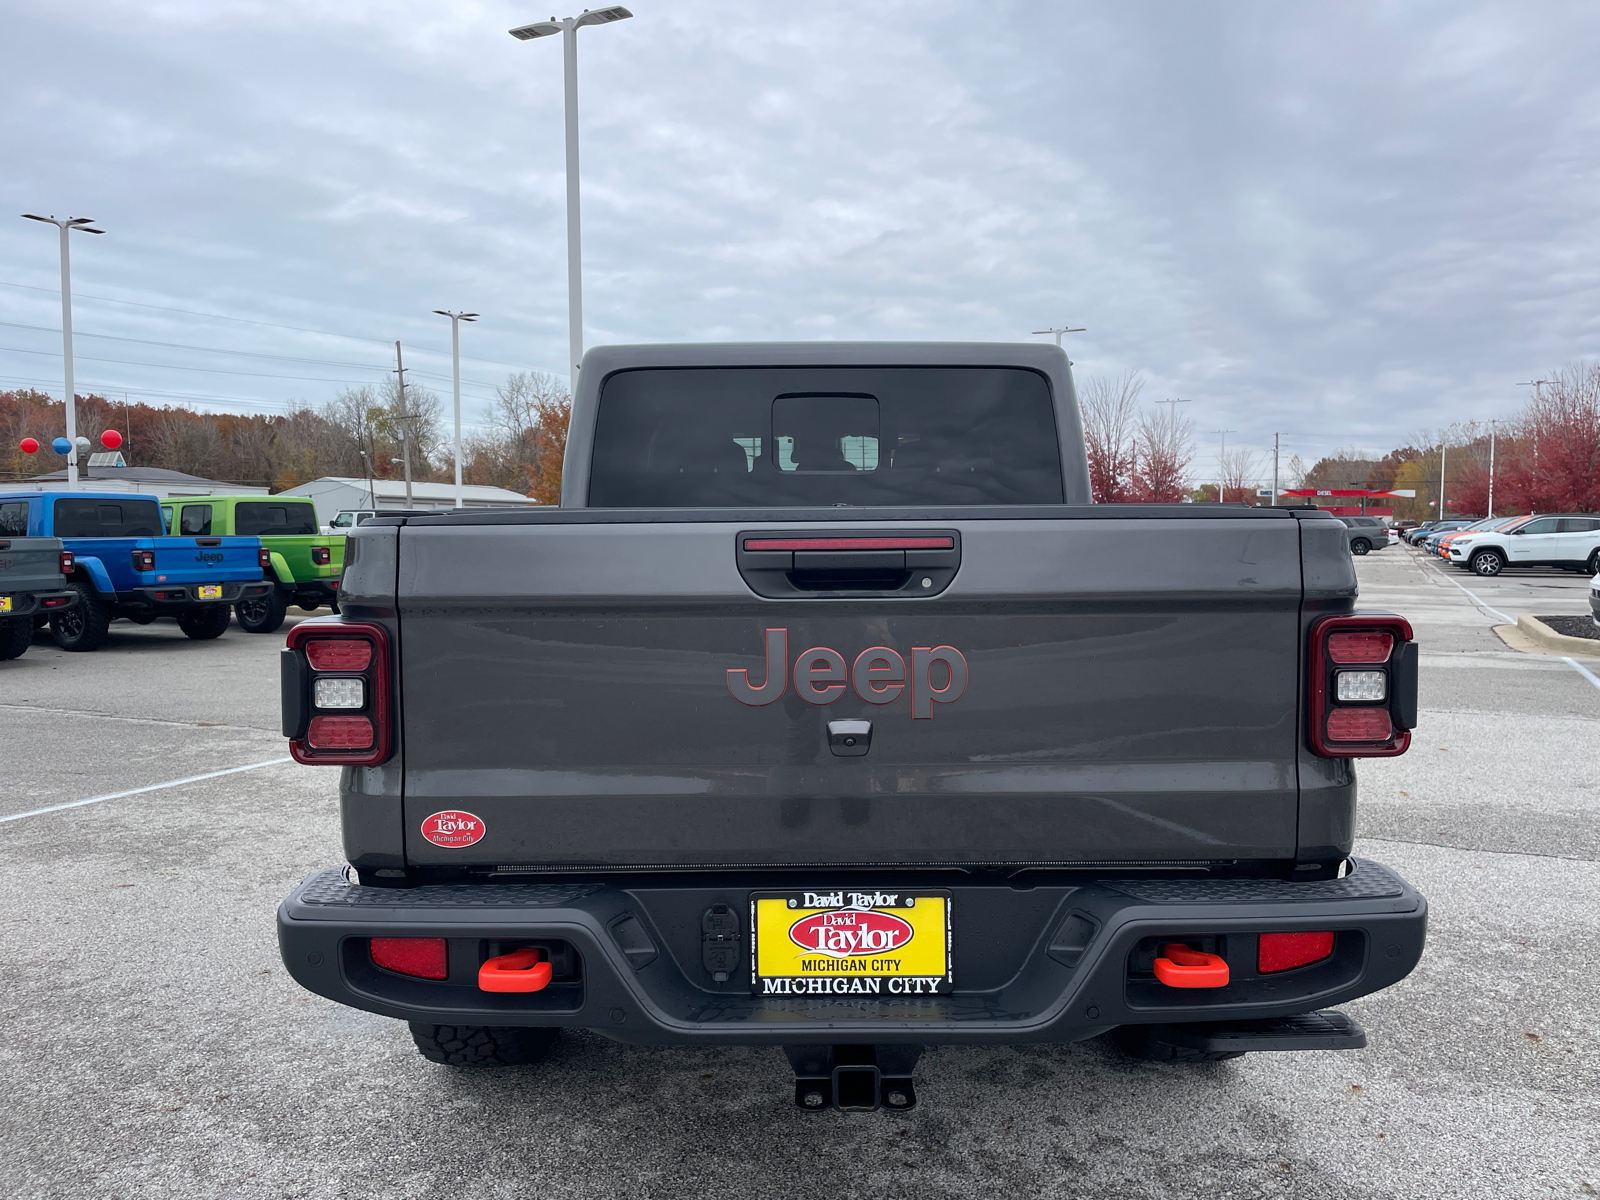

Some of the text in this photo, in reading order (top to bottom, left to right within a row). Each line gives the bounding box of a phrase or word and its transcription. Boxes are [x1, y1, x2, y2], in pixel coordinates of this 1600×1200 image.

[195, 551, 224, 563] Jeep
[726, 627, 969, 720] Jeep
[433, 818, 477, 834] Taylor
[432, 835, 475, 843] Michigan City
[803, 892, 899, 911] David Taylor
[822, 913, 856, 926] David
[806, 922, 901, 956] Taylor
[801, 959, 902, 972] MICHIGAN CITY
[762, 977, 943, 994] MICHIGAN CITY
